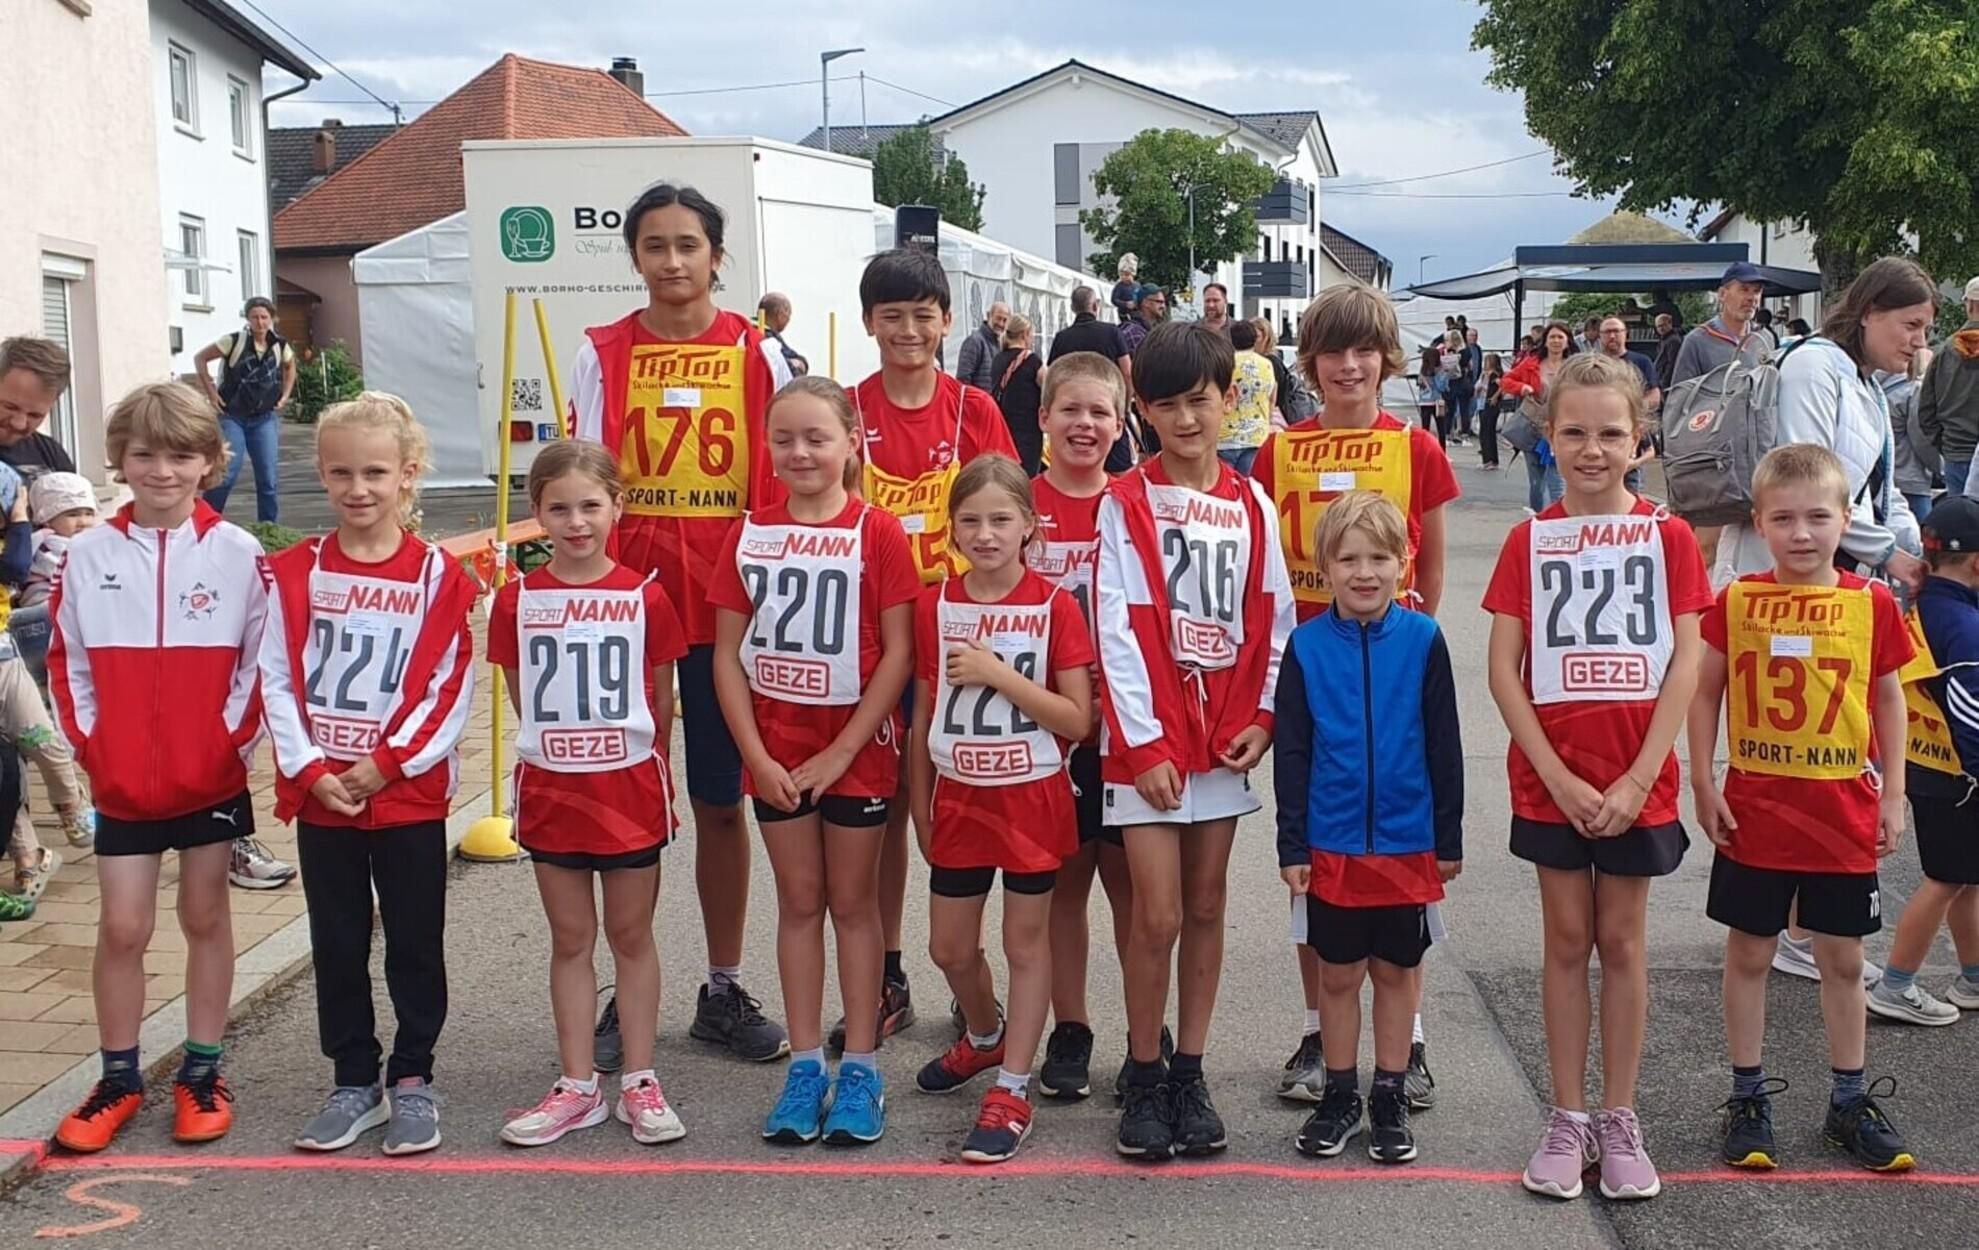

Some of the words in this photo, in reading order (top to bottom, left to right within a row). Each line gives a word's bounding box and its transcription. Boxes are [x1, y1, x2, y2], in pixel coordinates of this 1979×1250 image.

[625, 406, 736, 478] 176
[1187, 498, 1243, 528] NANN
[784, 533, 857, 558] NANN
[1538, 534, 1578, 549] SPORT
[1579, 523, 1652, 548] NANN
[1163, 528, 1238, 623] 216
[348, 585, 420, 616] NANN
[524, 607, 563, 622] SPORT
[564, 599, 639, 623] NANN
[742, 563, 848, 656] 220
[1540, 555, 1657, 648] 223
[977, 614, 1047, 640] NANN
[1185, 625, 1228, 654] GEZ
[529, 635, 630, 722] 219
[760, 661, 822, 691] GEZE
[1570, 661, 1642, 684] GEZE
[1734, 650, 1852, 735] 137
[549, 735, 621, 758] GEZE
[959, 749, 1024, 772] GEZE
[34, 1173, 192, 1238] S
